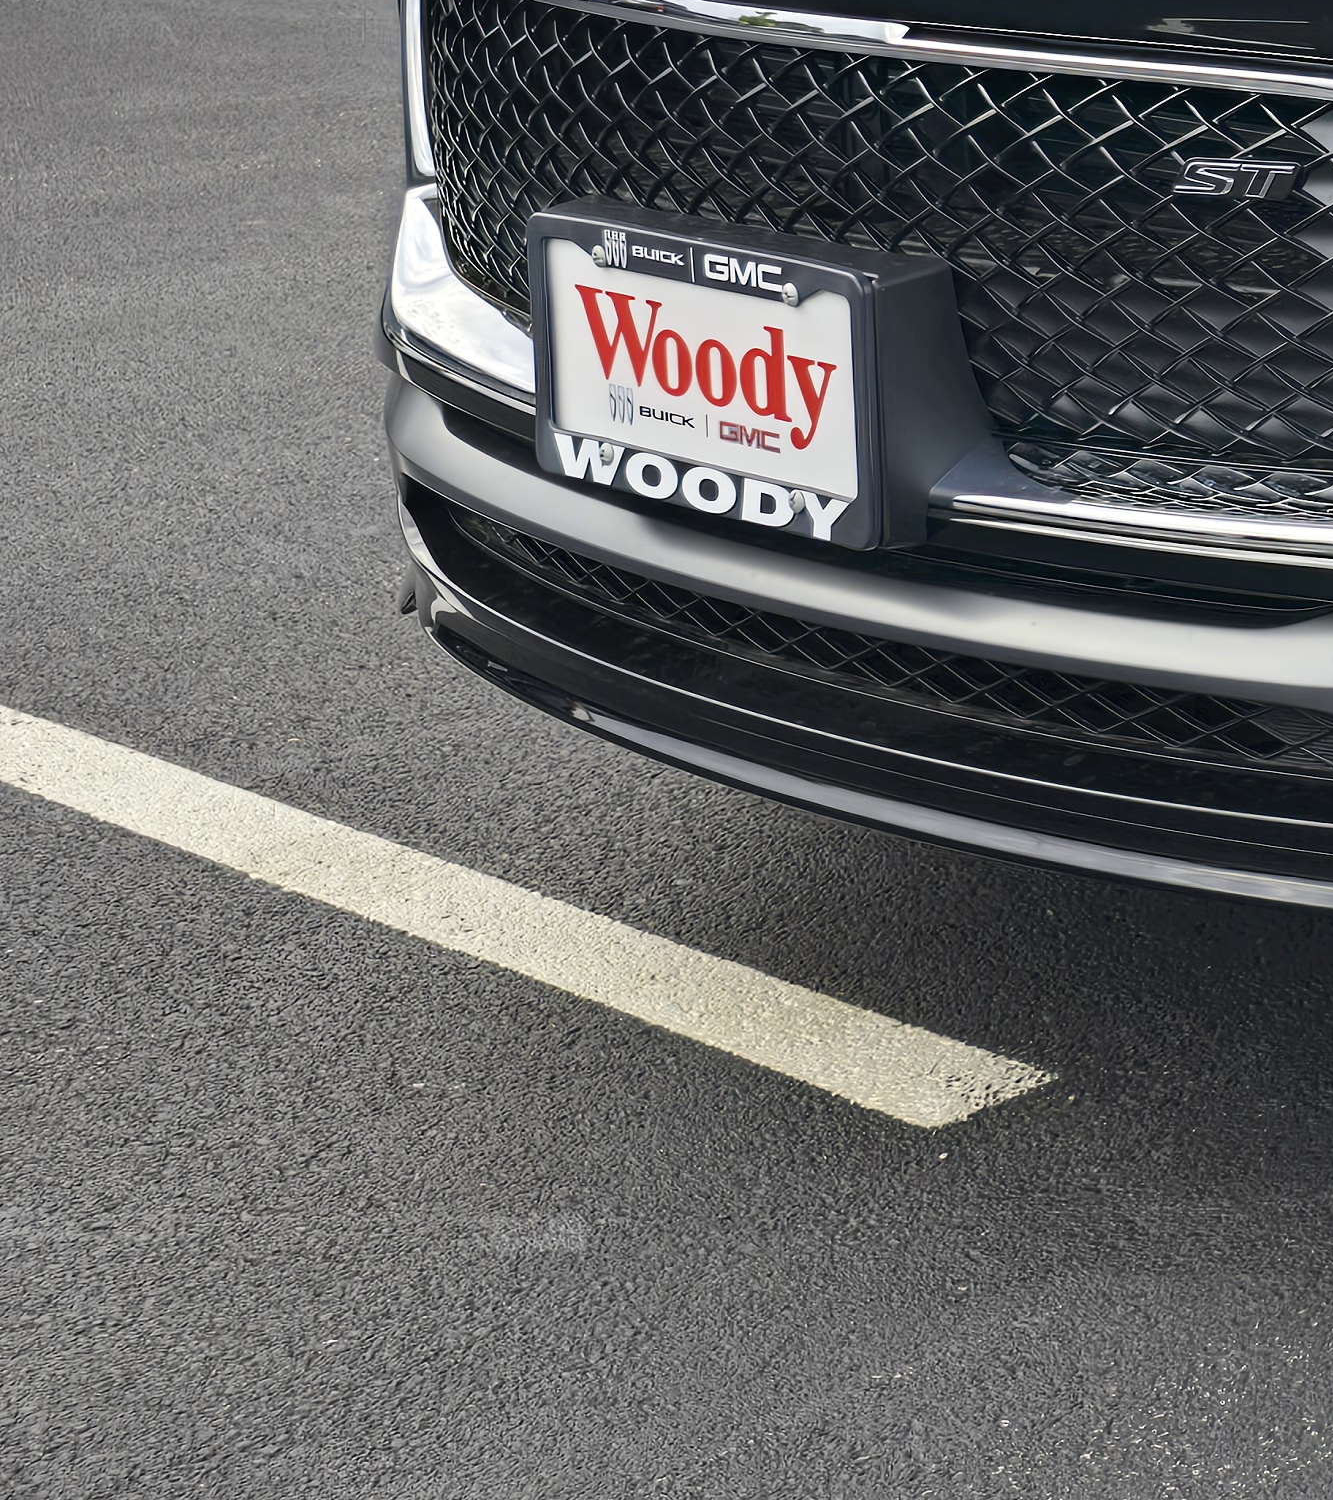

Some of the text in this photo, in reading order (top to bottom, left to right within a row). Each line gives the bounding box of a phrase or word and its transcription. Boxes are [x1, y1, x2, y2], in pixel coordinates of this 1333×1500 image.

[1173, 161, 1296, 198] ST
[631, 245, 784, 293] BUICK GMC
[575, 284, 837, 452] Woody
[639, 405, 781, 454] BUICK GMC
[553, 432, 852, 542] WOODY
